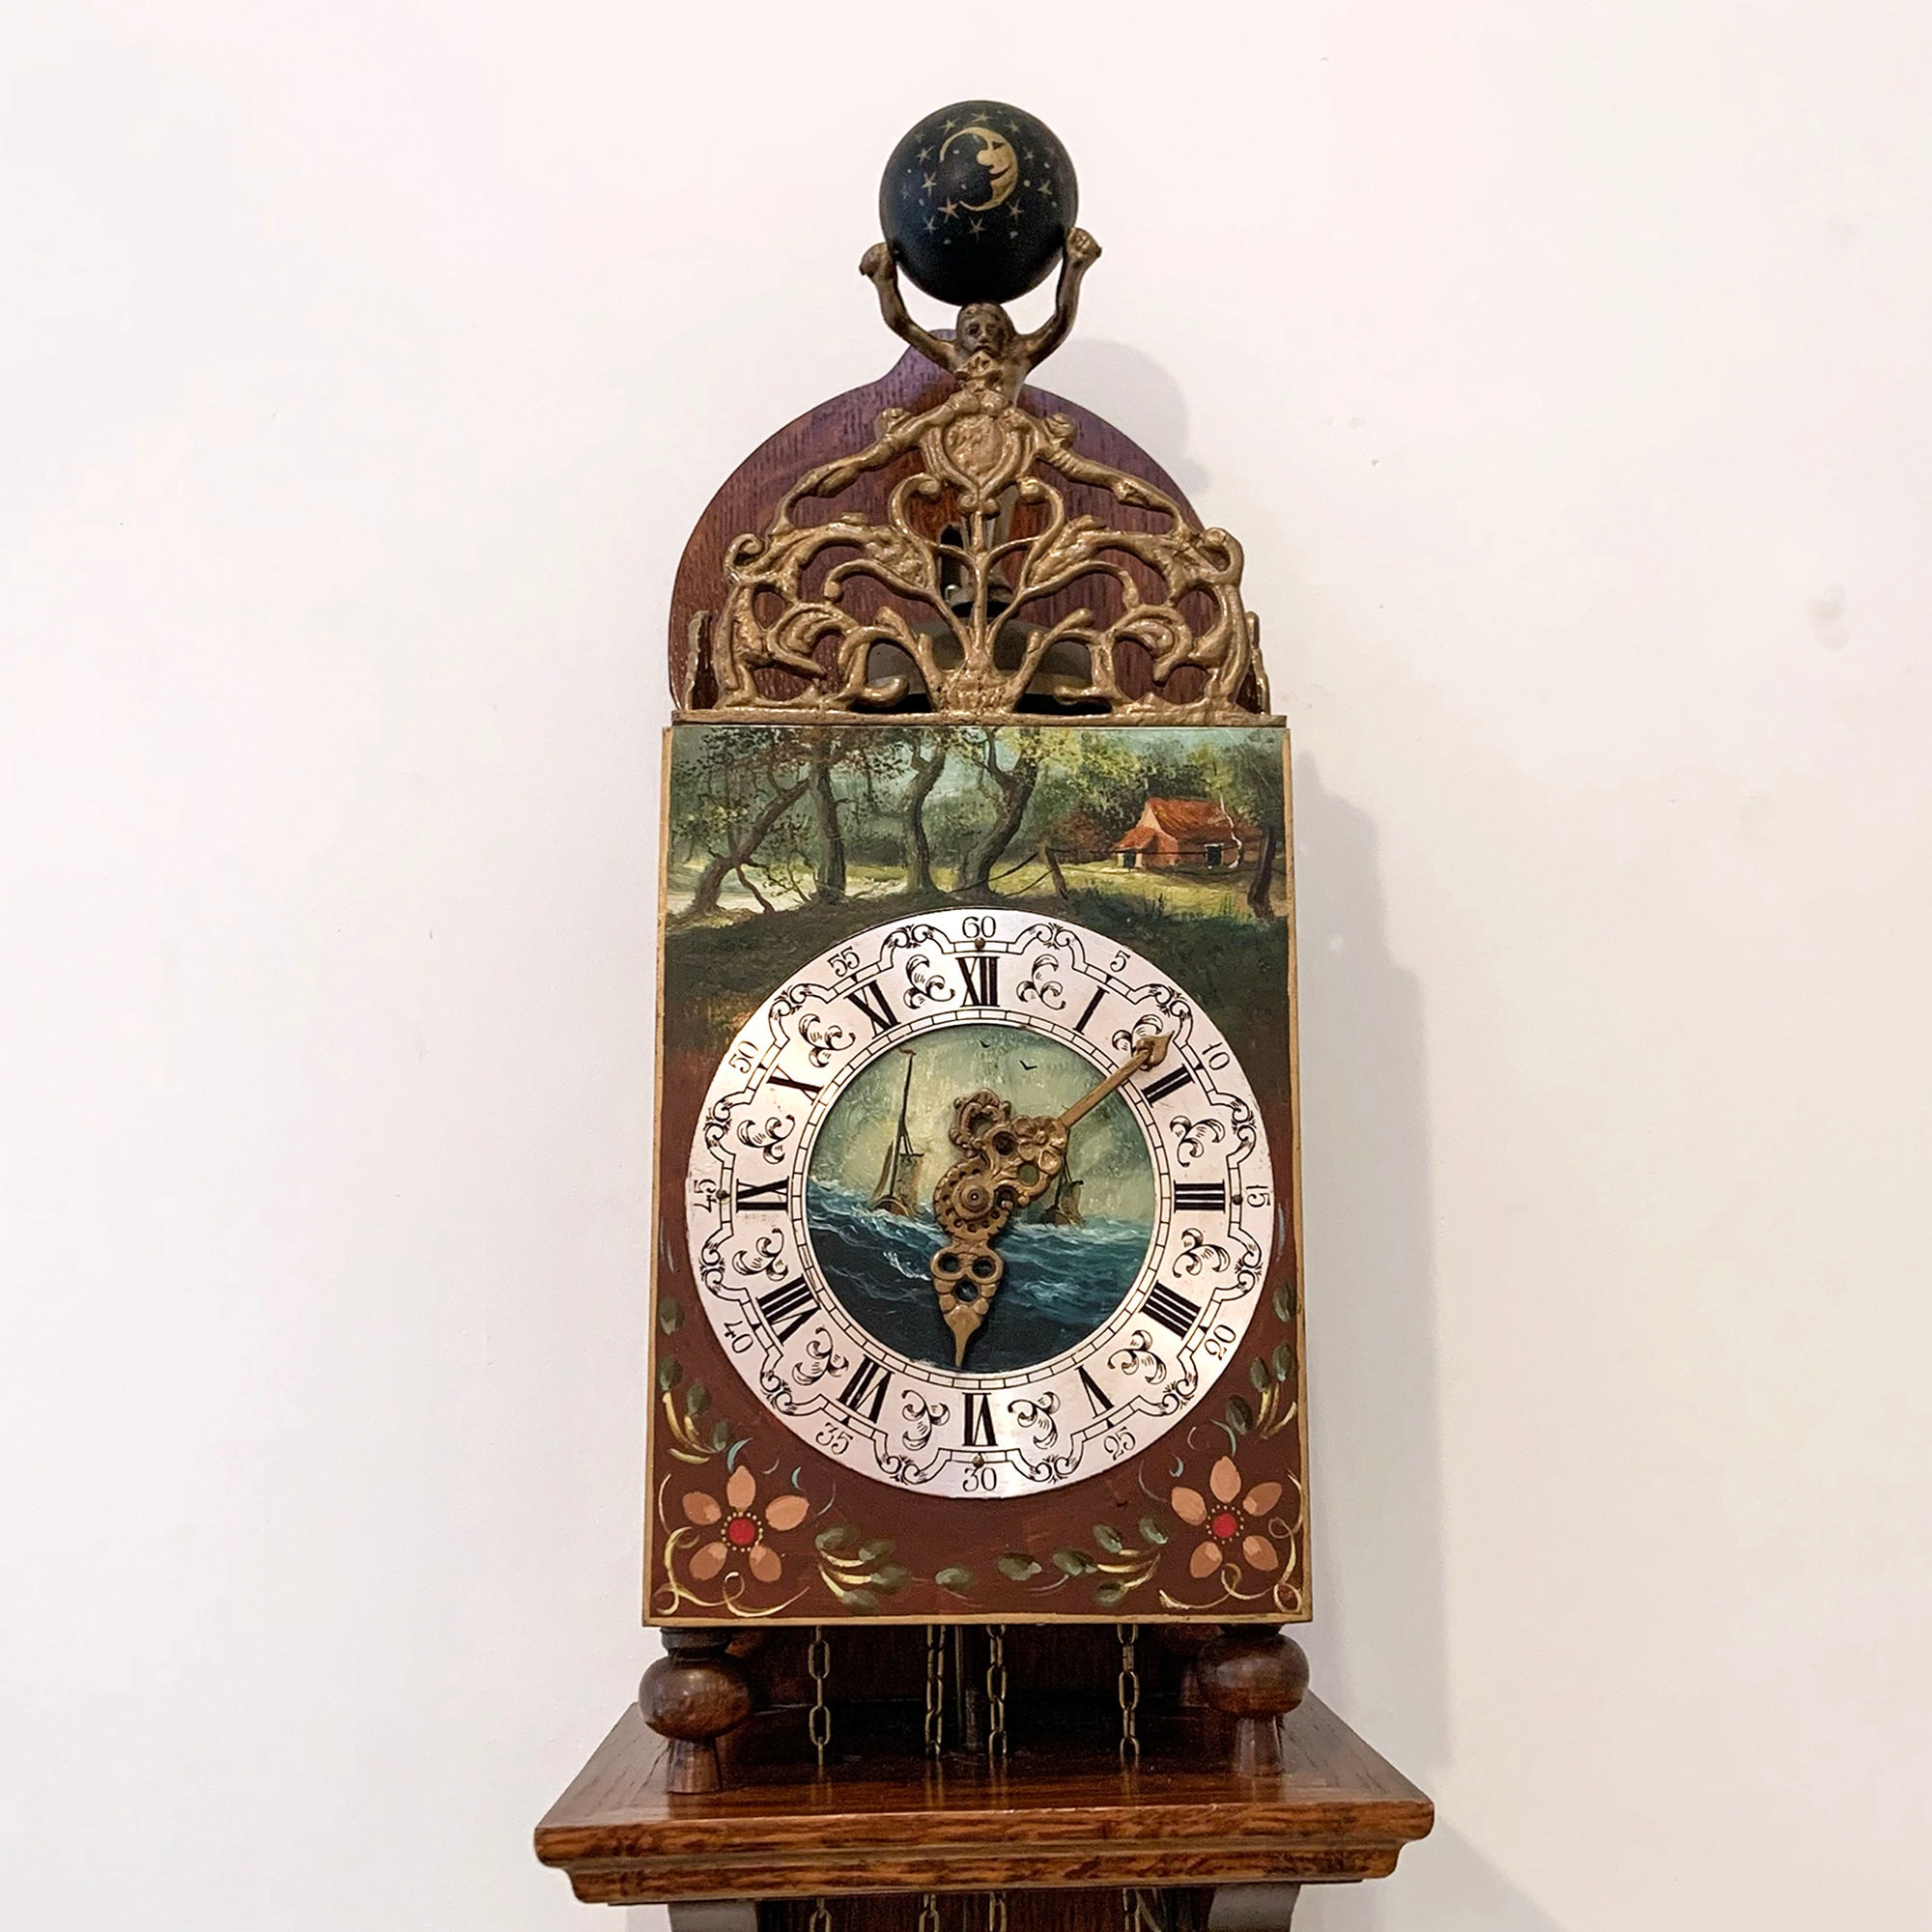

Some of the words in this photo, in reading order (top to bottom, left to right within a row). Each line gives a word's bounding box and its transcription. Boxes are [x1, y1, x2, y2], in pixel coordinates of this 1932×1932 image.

[962, 916, 997, 939] 60
[827, 947, 861, 978] 55
[1110, 950, 1131, 973] 5
[955, 956, 1001, 1008] XII
[844, 980, 901, 1039] XI
[728, 1040, 759, 1074] 50
[1202, 1041, 1230, 1071] 10
[766, 1064, 824, 1106] X
[1141, 1064, 1196, 1108] II
[694, 1179, 717, 1213] 45
[736, 1176, 790, 1213] IX
[1174, 1179, 1226, 1214] III
[1246, 1184, 1270, 1208] 15
[755, 1273, 822, 1346] VIII
[1139, 1280, 1202, 1341] IIII
[724, 1321, 753, 1354] 40
[1204, 1324, 1236, 1361] 20
[836, 1353, 895, 1424] VII
[815, 1422, 853, 1455] 35
[1103, 1426, 1136, 1461] 25
[962, 1467, 997, 1492] 30
